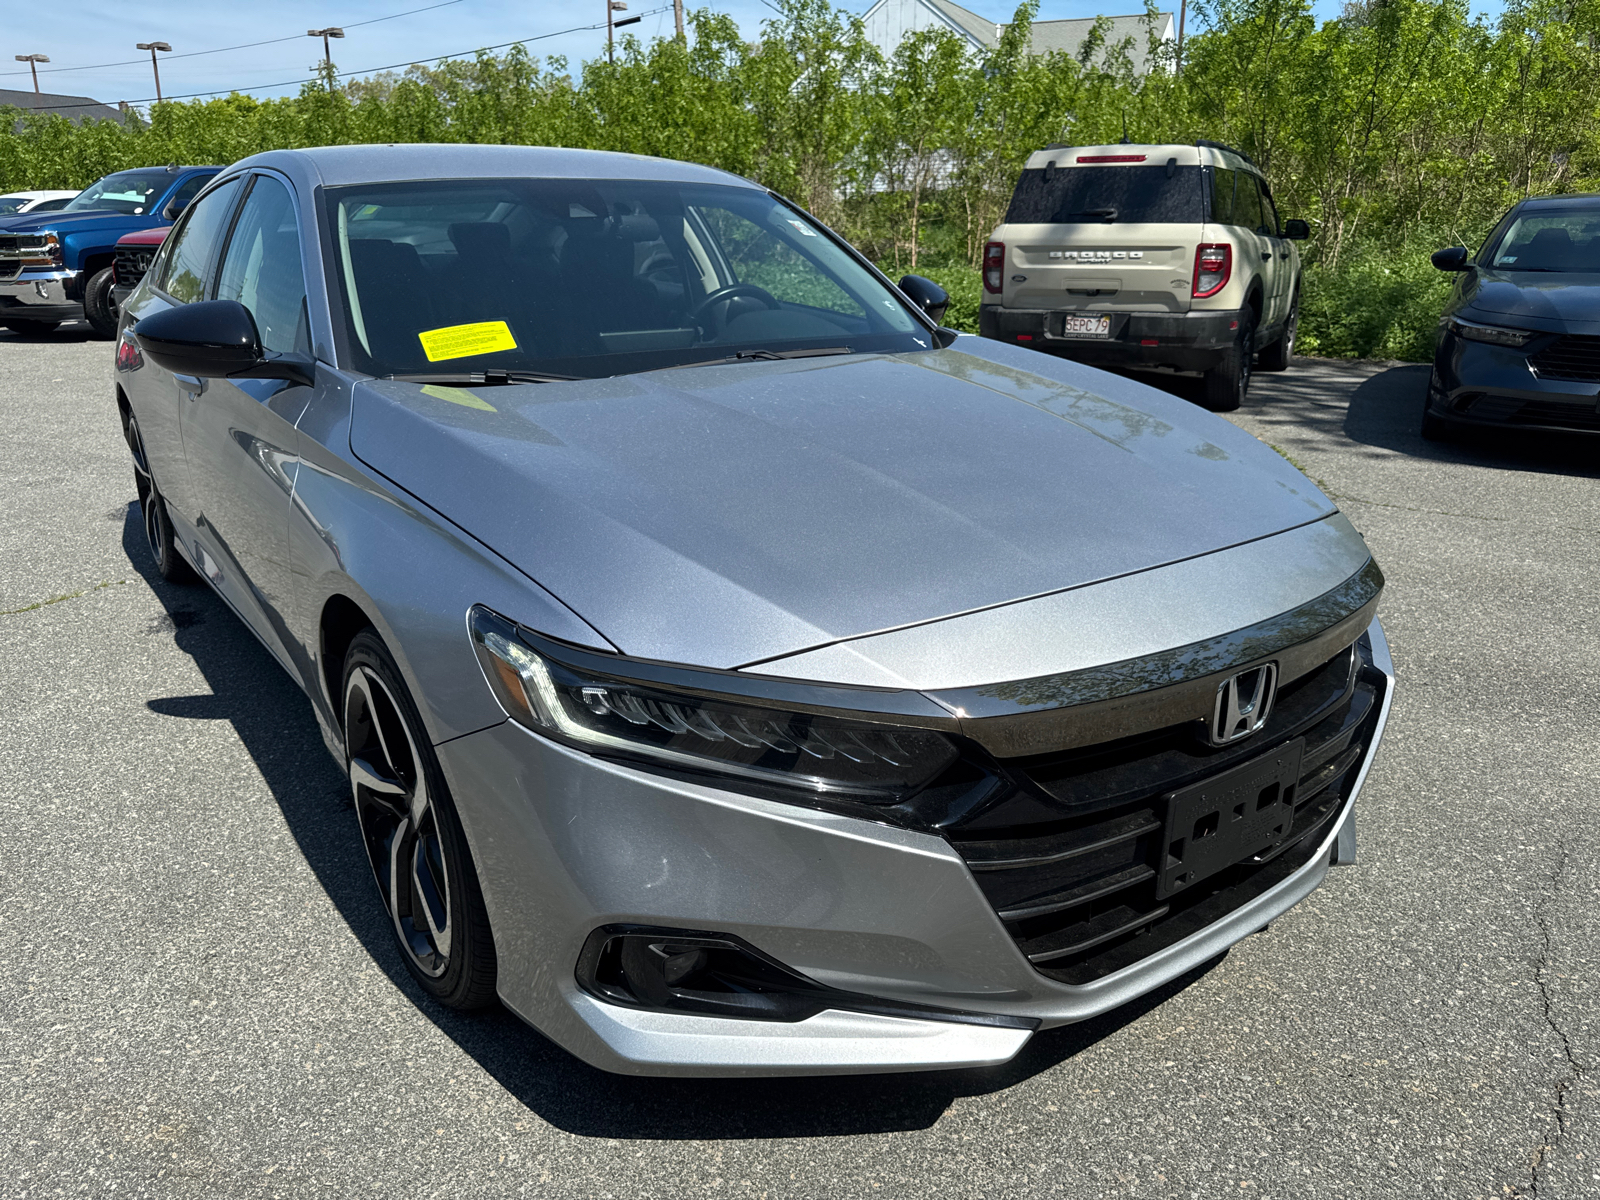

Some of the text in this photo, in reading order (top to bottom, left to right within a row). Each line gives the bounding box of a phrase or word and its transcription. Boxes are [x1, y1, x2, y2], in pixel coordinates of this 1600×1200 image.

[1049, 251, 1143, 259] BRONCO
[1066, 318, 1108, 332] 5EPC 79
